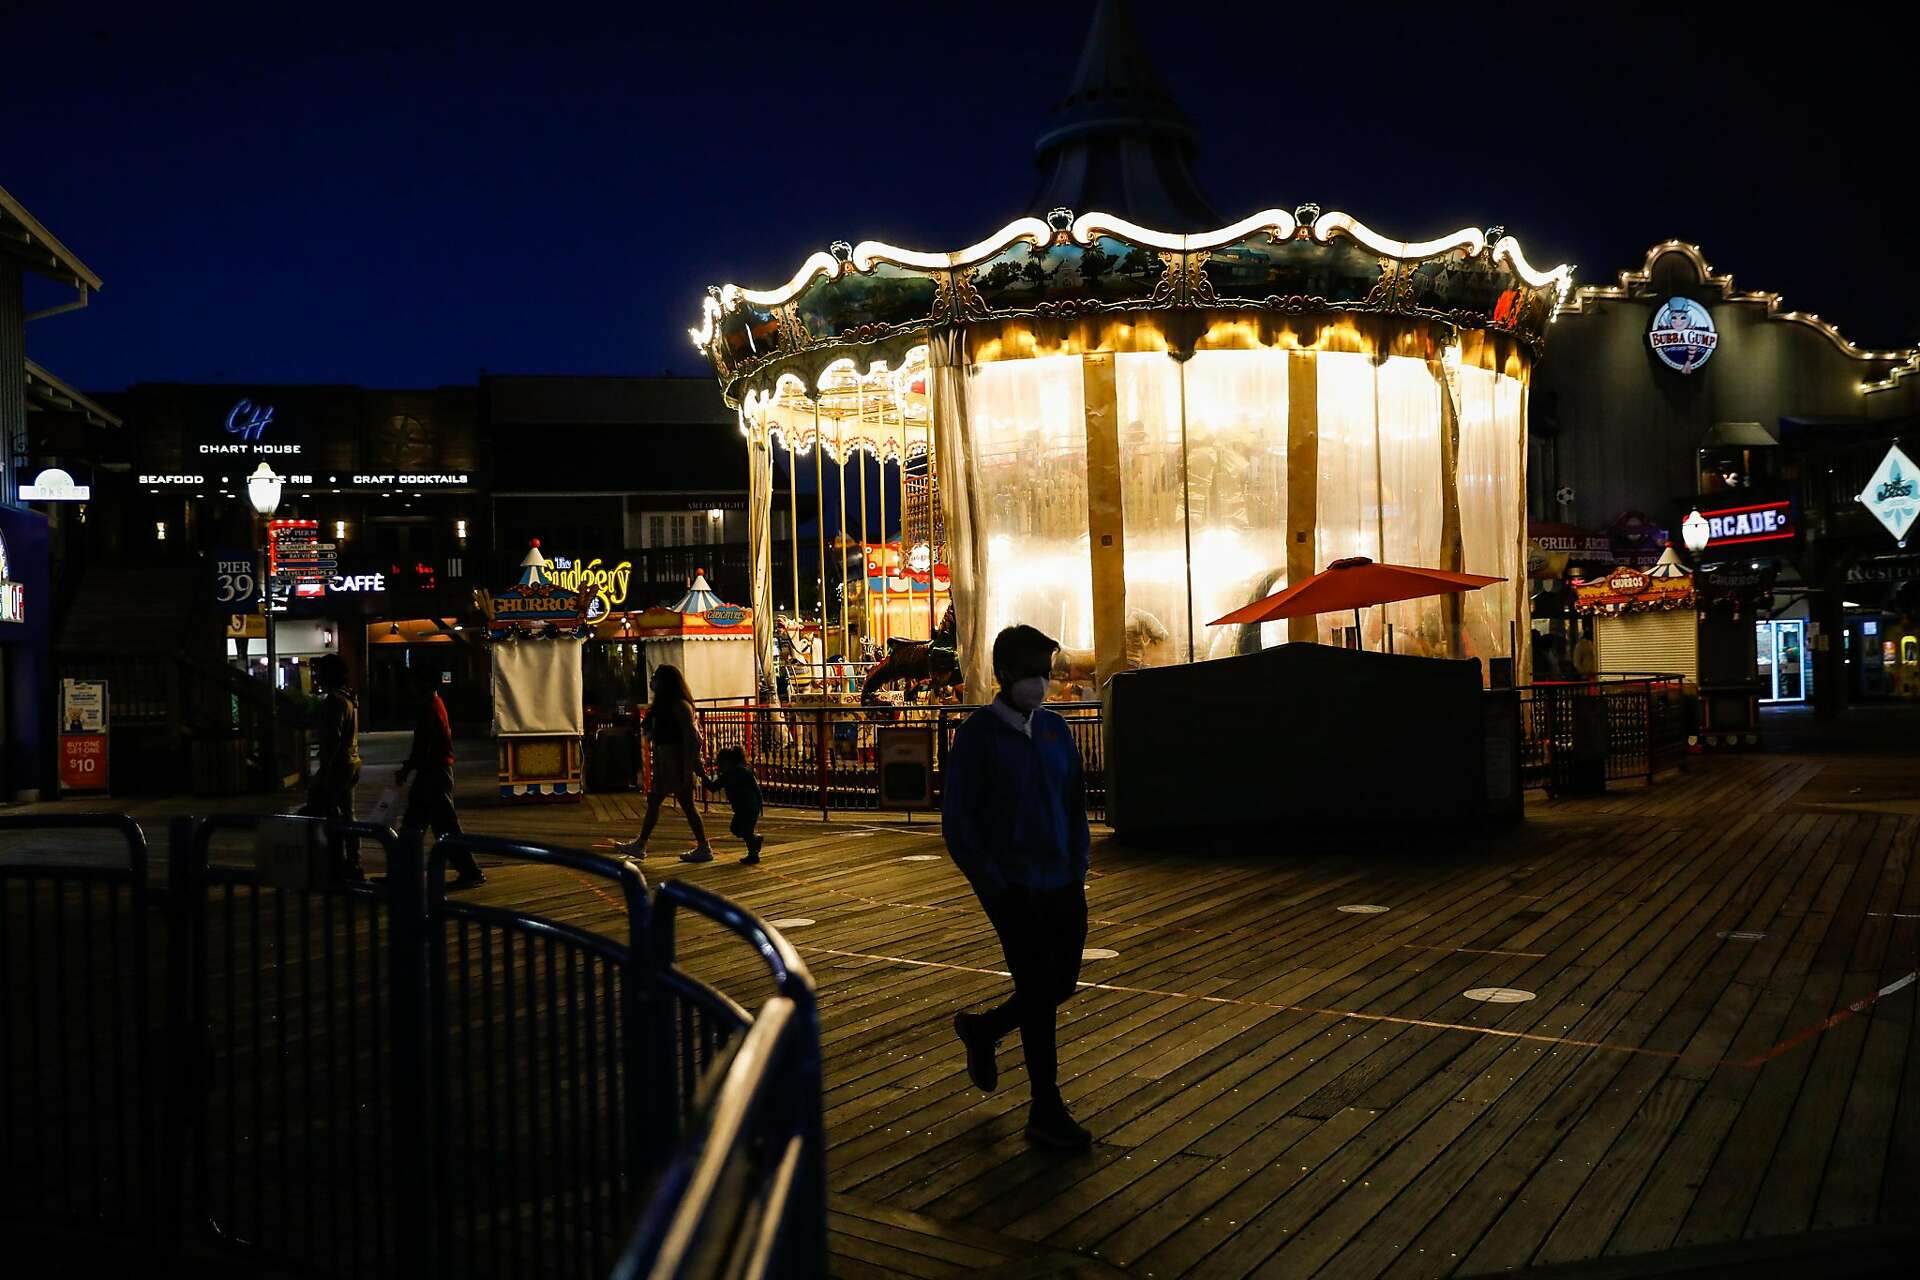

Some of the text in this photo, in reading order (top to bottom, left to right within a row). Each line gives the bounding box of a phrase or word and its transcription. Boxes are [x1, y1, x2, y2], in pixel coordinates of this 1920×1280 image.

[1652, 330, 1716, 346] BUBBA GUMP
[225, 399, 274, 441] CH
[199, 444, 302, 454] CHART HOUSE
[138, 474, 205, 484] SEAFOOD
[289, 474, 313, 484] RIB
[352, 474, 396, 484] CRAFT
[398, 474, 469, 484] COCKTAILS
[1708, 509, 1778, 539] RCADE
[1539, 536, 1577, 550] GRILL
[217, 561, 252, 574] PIER
[216, 574, 254, 602] 39
[1611, 576, 1643, 589] CHURROS
[494, 597, 579, 612] CHURROS
[69, 758, 95, 772] $10
